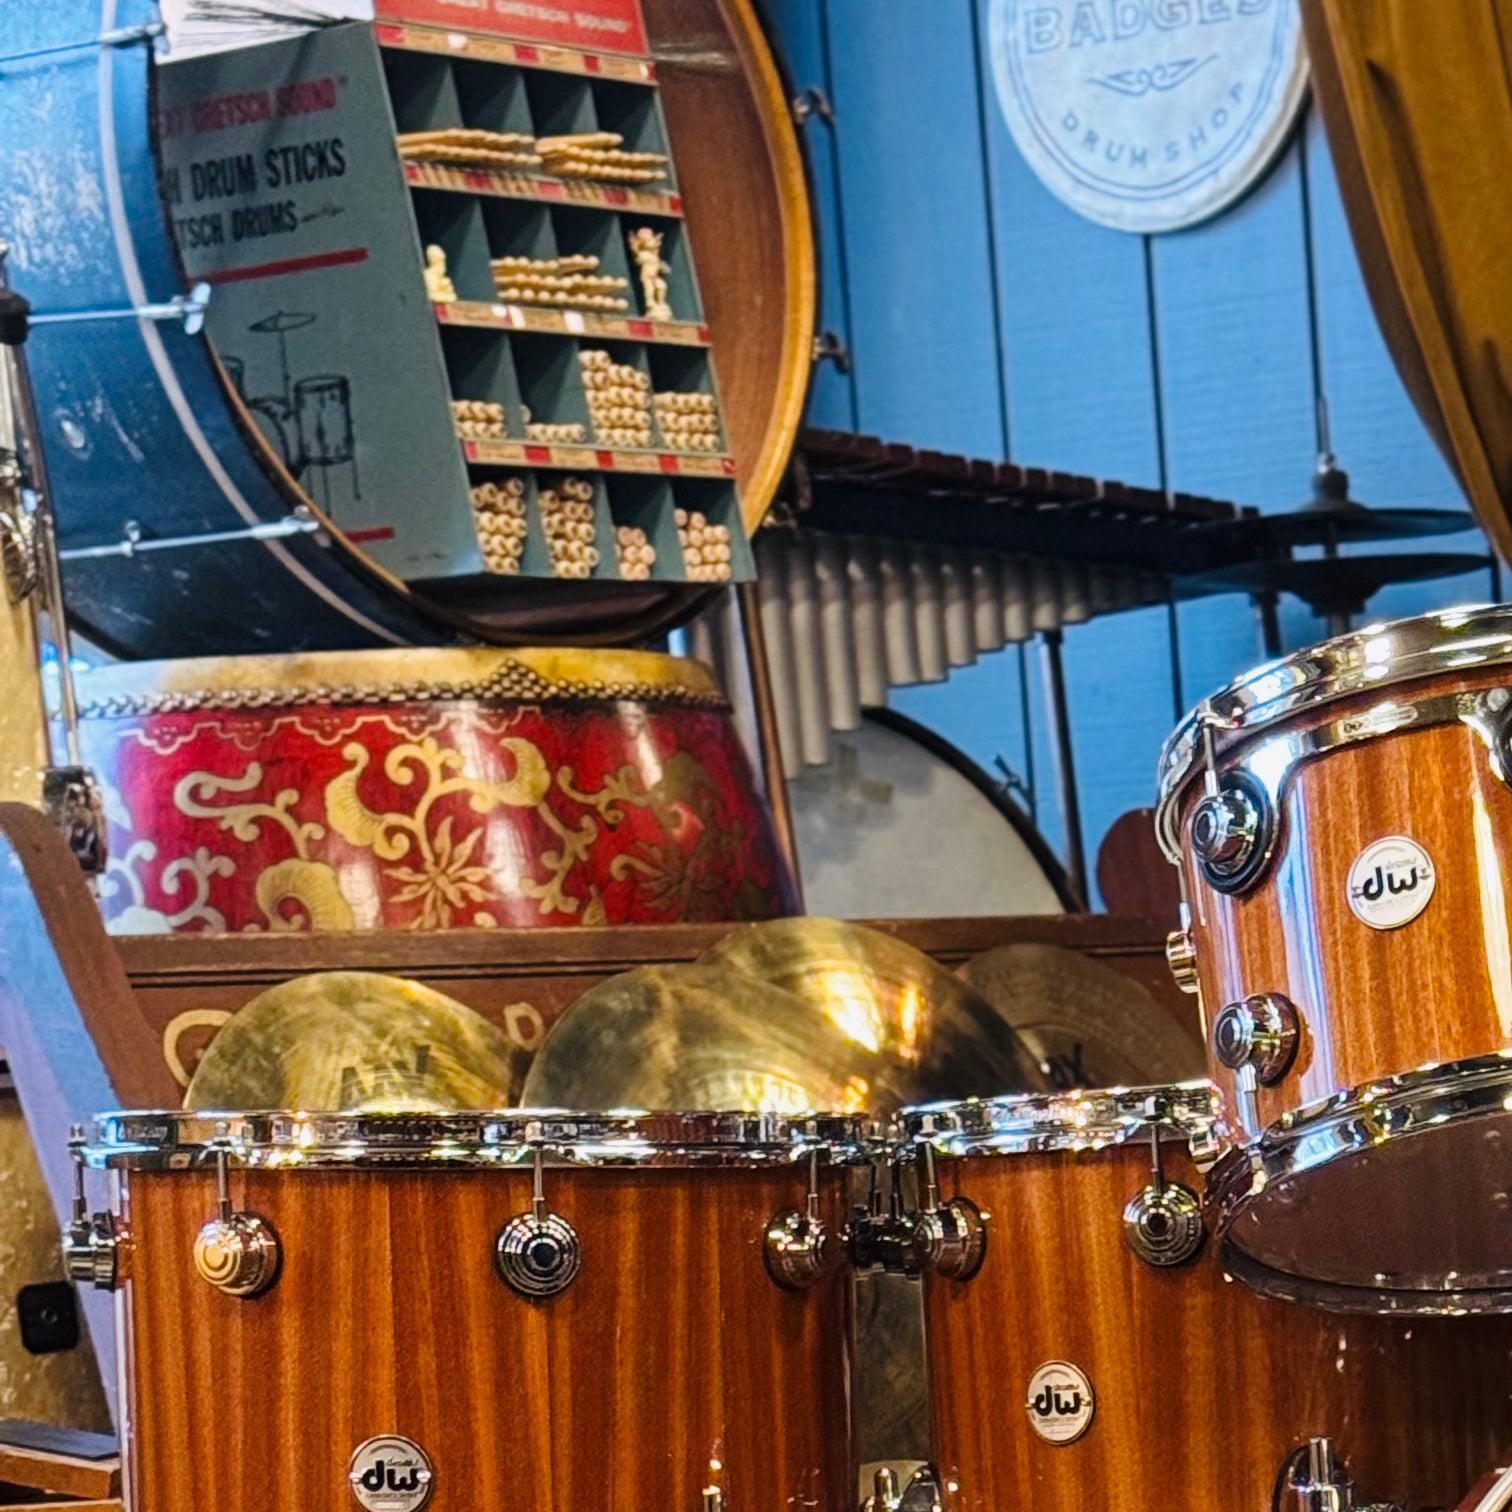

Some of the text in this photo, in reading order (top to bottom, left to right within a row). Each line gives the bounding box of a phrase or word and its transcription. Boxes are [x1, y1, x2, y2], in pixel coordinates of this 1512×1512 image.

[1061, 82, 1244, 168] DRUM SHOP
[189, 153, 258, 202] DRUM
[264, 137, 346, 188] STICKS
[173, 199, 298, 249] TSCH DRUMS
[1362, 866, 1418, 901] dw
[1035, 1385, 1080, 1417] dw
[361, 1460, 420, 1492] dw
